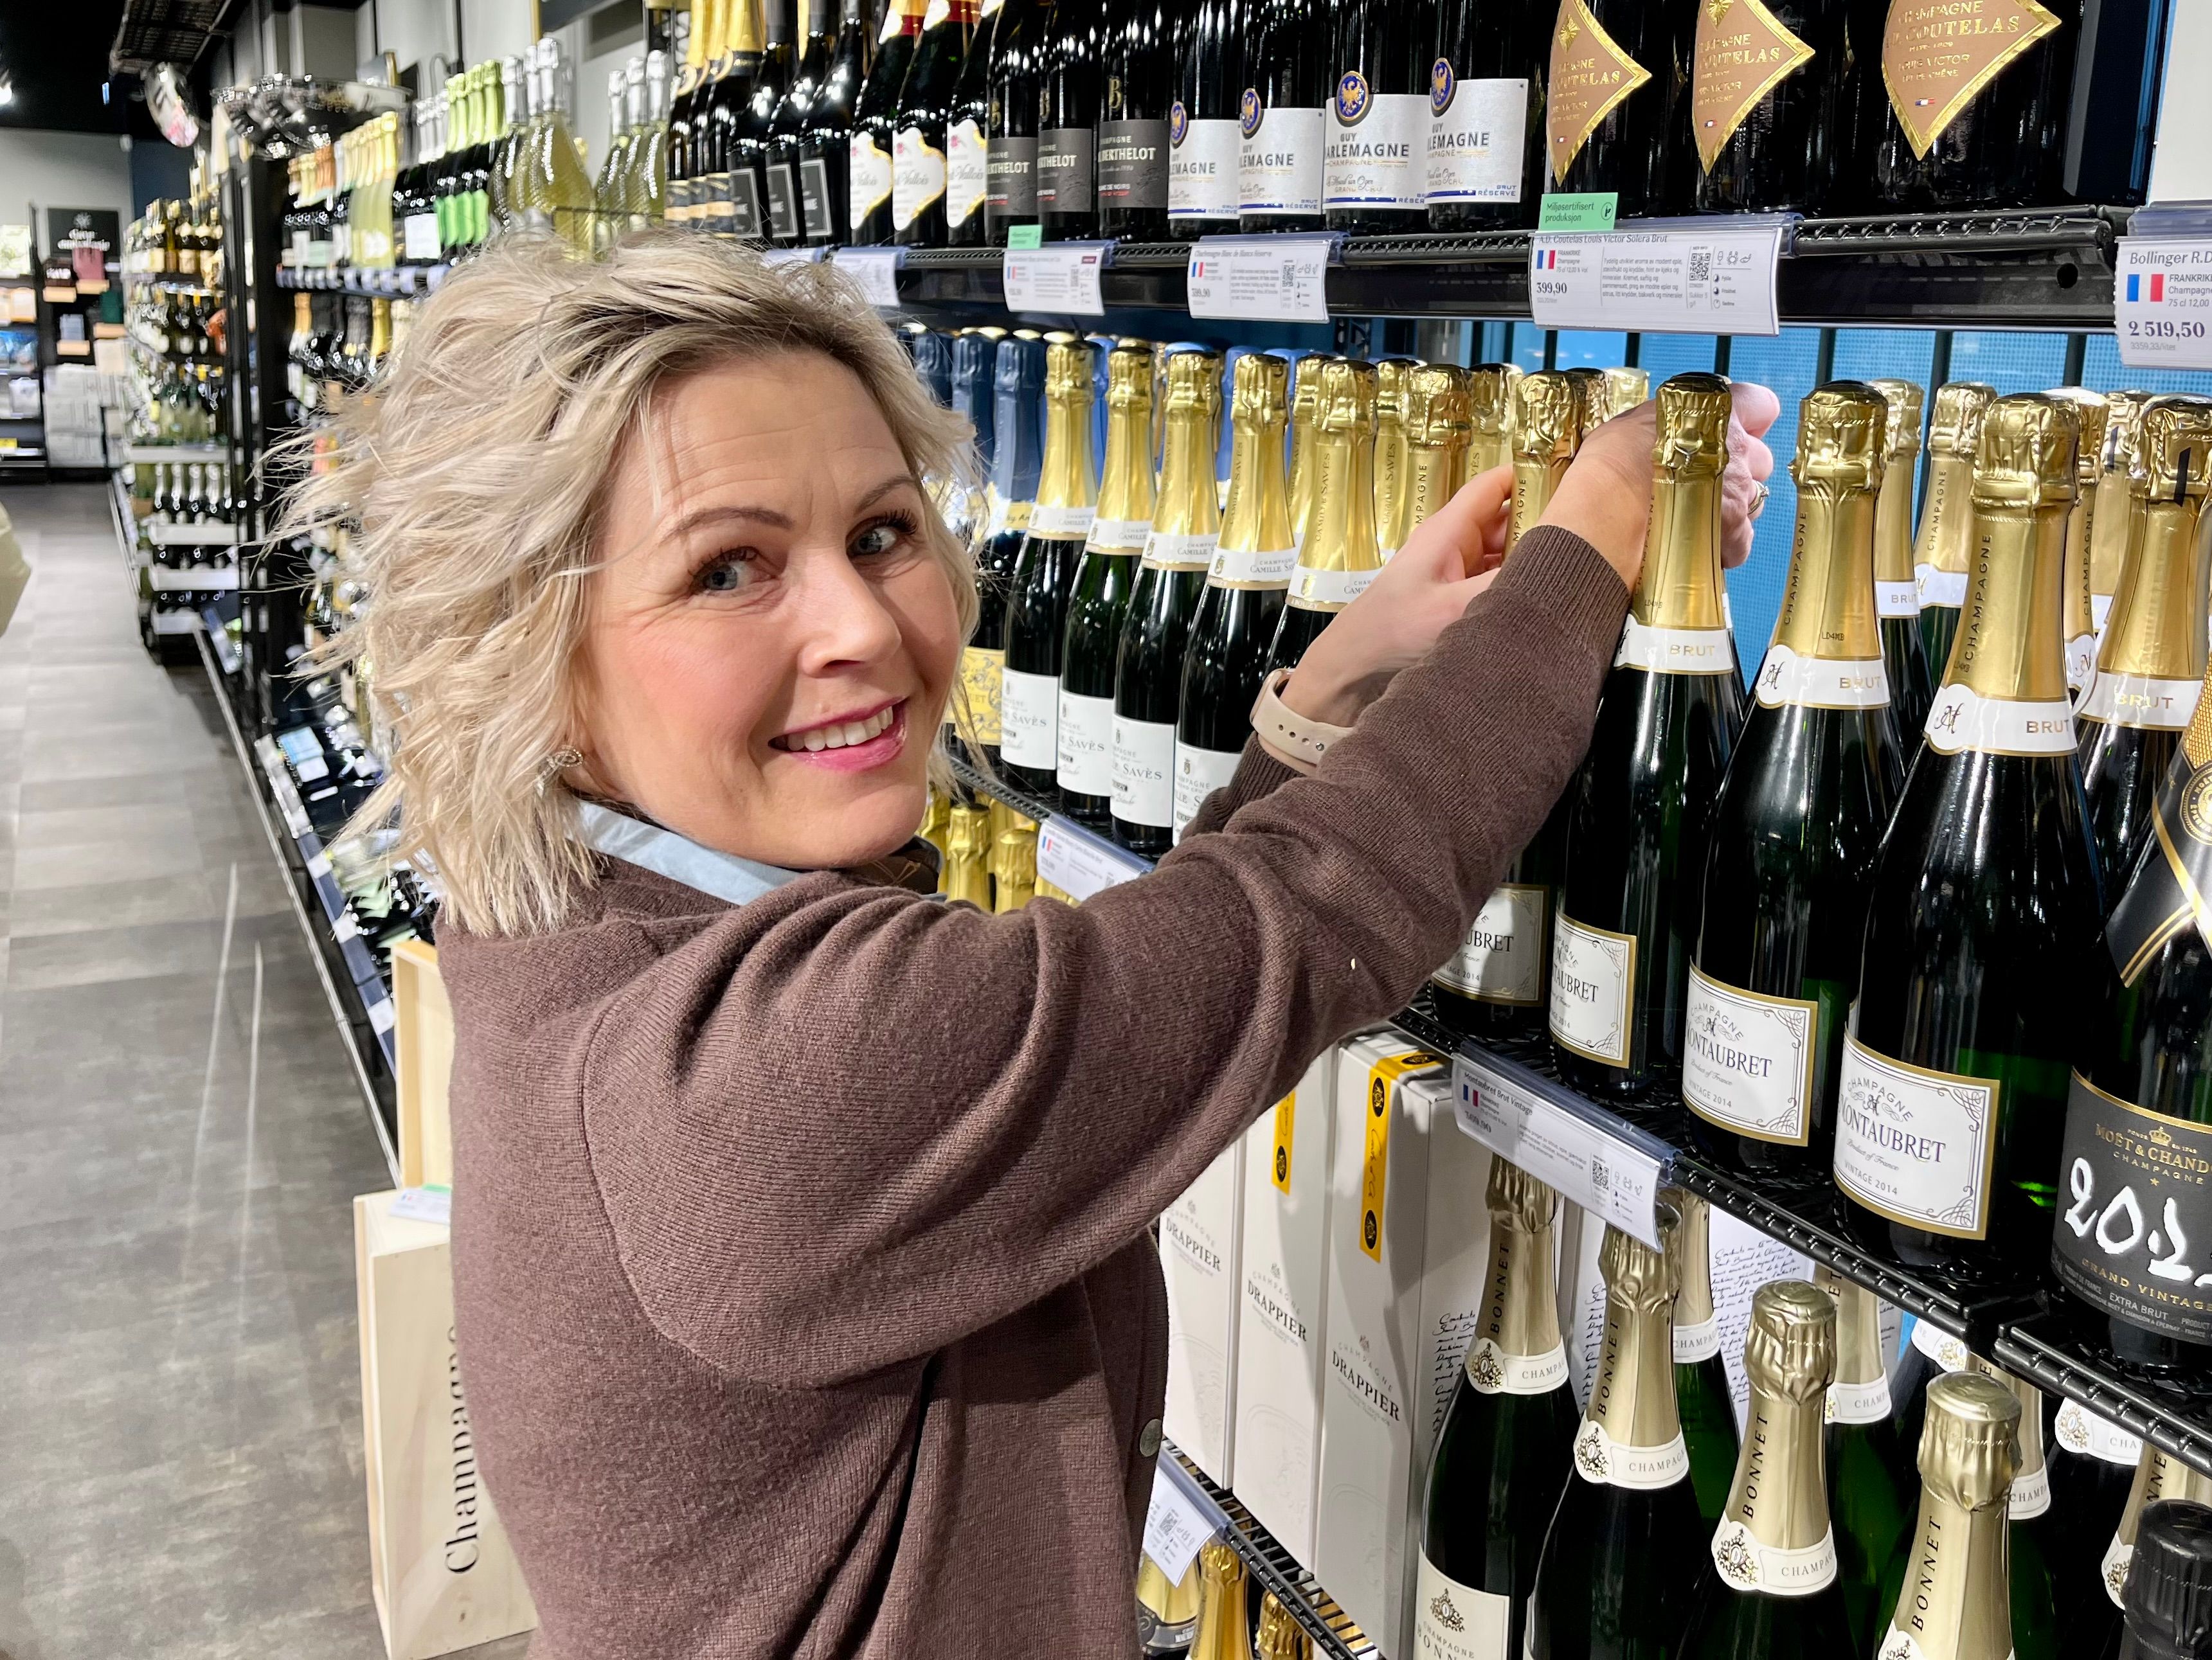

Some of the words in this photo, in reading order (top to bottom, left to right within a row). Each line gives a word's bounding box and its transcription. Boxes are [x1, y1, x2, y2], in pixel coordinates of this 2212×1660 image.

[1898, 1, 1983, 25] CHAMPAGNE
[1906, 15, 2020, 41] COUTELAS
[1927, 54, 1970, 66] VICTOR
[1340, 133, 1357, 142] GUY
[1428, 132, 1489, 151] LEMAGNE
[1239, 154, 1294, 168] LEMAGNE
[1326, 144, 1410, 158] ARLEMAGNE
[1545, 213, 1582, 223] produksjon
[1546, 201, 1594, 212] Miljøsertifisert
[1554, 235, 1583, 244] Coutelas
[1626, 234, 1650, 243] Solera
[1651, 234, 1668, 242] Brut
[2130, 251, 2188, 267] Bollinger
[1536, 283, 1567, 296] 399,90
[2168, 299, 2177, 307] 75
[2189, 299, 2209, 308] 12,00
[1415, 463, 1428, 524] MPAGNE
[1513, 477, 1527, 542] MPAGNE
[1927, 469, 1947, 551] CHAMPAGNE
[1250, 565, 1281, 573] CAMILLE
[1784, 512, 1808, 625] CHAMPAGNE
[1891, 594, 1918, 603] BRUT
[1965, 534, 1992, 661] CHAMPAGNE
[1670, 644, 1714, 656] BRUT
[1839, 676, 1882, 690] BRUT
[2116, 693, 2174, 711] BRUT
[2026, 718, 2070, 734] BRUT
[1070, 735, 1105, 753] SAVÈS
[1123, 763, 1162, 781] SAVÈS
[1466, 929, 1515, 954] UBRET
[1555, 934, 1578, 968] PAGNE
[1462, 971, 1480, 981] 2014
[1553, 963, 1599, 1003] TAUBRET
[1691, 1002, 1744, 1042] CHAMPAGNE
[1464, 1071, 1496, 1096] Montaubret
[1497, 1089, 1509, 1103] Brut
[1511, 1096, 1533, 1116] Vintage
[1713, 1093, 1732, 1108] 2014
[1848, 1076, 1914, 1123] CHAMPAGNE
[2095, 1123, 2134, 1152] MOËT
[2135, 1144, 2145, 1157] &
[1874, 1155, 1900, 1172] France
[2113, 1151, 2204, 1185] CHAMPAGNE
[1844, 1159, 1873, 1186] VINTAGE
[1875, 1179, 1898, 1195] 2014
[1166, 1218, 1221, 1272] DRAPPIER
[2082, 1258, 2130, 1288] GRAND
[1489, 1245, 1509, 1335] BONNET
[1247, 1280, 1307, 1343] DRAPPIER
[2109, 1292, 2138, 1311] EXTRA
[2141, 1305, 2169, 1321] BRUT
[2181, 1317, 2210, 1330] PRODUCT
[1338, 1341, 1393, 1393] CHAMPAGNE
[1597, 1321, 1619, 1417] BONNET
[1332, 1348, 1400, 1422] DRAPPIER
[1742, 1412, 1768, 1520] BONNET
[1911, 1515, 1942, 1632] BONNET
[1423, 1621, 1474, 1659] CHAMPAGNE
